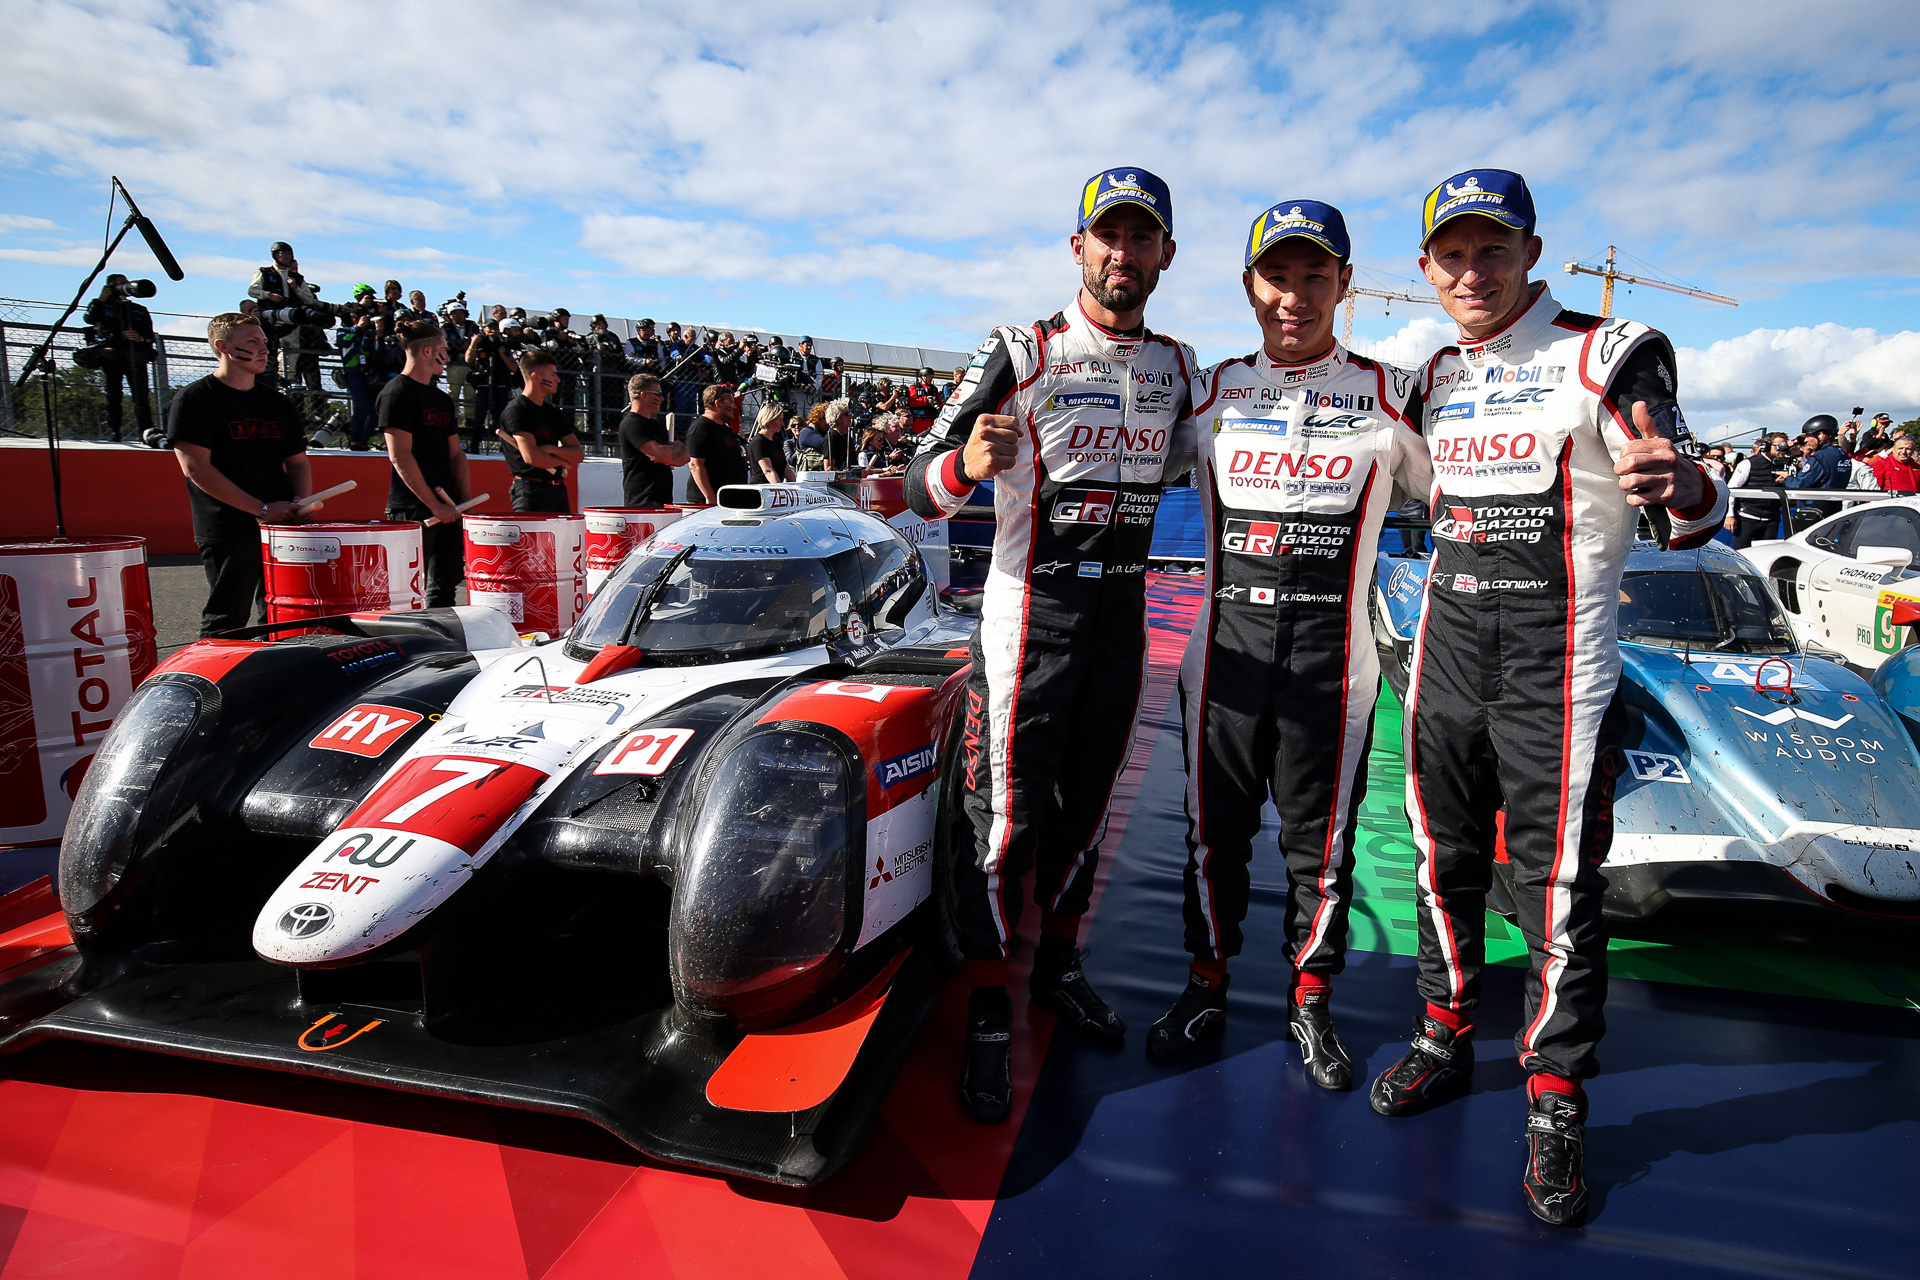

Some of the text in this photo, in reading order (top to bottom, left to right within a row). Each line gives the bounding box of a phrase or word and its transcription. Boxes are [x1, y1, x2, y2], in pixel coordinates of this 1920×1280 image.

[1096, 188, 1157, 206] MICHELIN
[1434, 194, 1505, 221] MICHELIN
[1262, 220, 1324, 244] MICHELIN
[1485, 333, 1513, 348] TOYOTA
[1051, 361, 1085, 376] ZENT
[1485, 365, 1541, 384] Mobil
[1108, 377, 1120, 385] AW
[1068, 397, 1115, 406] MICHELIN
[1136, 390, 1173, 404] WEC
[1220, 387, 1255, 400] ZENT
[1304, 389, 1354, 410] Mobil
[1485, 386, 1555, 405] WEC
[1252, 403, 1275, 411] AISIN
[1232, 423, 1281, 432] MICHELIN
[1303, 414, 1367, 429] WEC
[1067, 425, 1167, 452] DENSO
[1433, 432, 1536, 463] DENSO
[1066, 452, 1118, 463] TOYOTA
[1229, 450, 1353, 480] DENSO
[1475, 461, 1541, 478] HYBRID
[1228, 476, 1352, 494] TOYOTA HYBRID
[769, 488, 800, 509] ZENT
[860, 486, 873, 511] HY
[1122, 491, 1160, 503] TOYOTA
[1117, 503, 1155, 514] GAZOO
[1473, 506, 1554, 519] TOYOTA
[1114, 513, 1152, 526] Racing
[1284, 522, 1352, 535] TOYOTA
[1473, 518, 1546, 531] GAZOO
[898, 522, 926, 544] DENSO
[1280, 534, 1344, 546] GAZOO
[1473, 530, 1542, 543] Racing
[697, 544, 789, 555] HYBRID
[1277, 546, 1340, 559] Racing
[408, 546, 422, 610] TAL
[572, 534, 584, 626] TOTAL
[1840, 567, 1882, 582] CHOPARD
[1290, 593, 1343, 603] KOBAYASHI
[1857, 628, 1871, 645] PRO
[326, 640, 391, 662] TOYOTA
[66, 576, 113, 747] TOTAL
[341, 652, 400, 676] HYBRID
[556, 694, 610, 707] Racing
[562, 692, 619, 701] GAZOO
[574, 686, 632, 698] TOYOTA
[328, 709, 412, 744] HY
[451, 735, 538, 750] WEC
[964, 688, 983, 792] DENSO
[1744, 730, 1885, 751] WISDOM
[610, 734, 678, 766] P1
[1776, 746, 1876, 764] AUDIO
[885, 748, 938, 784] AISIN
[1631, 754, 1685, 779] P2
[380, 758, 502, 824] 7
[1590, 752, 1616, 866] DENSO
[894, 838, 932, 868] MITSUBISHI
[894, 852, 928, 878] ELECTRIC
[299, 871, 380, 895] ZENT
